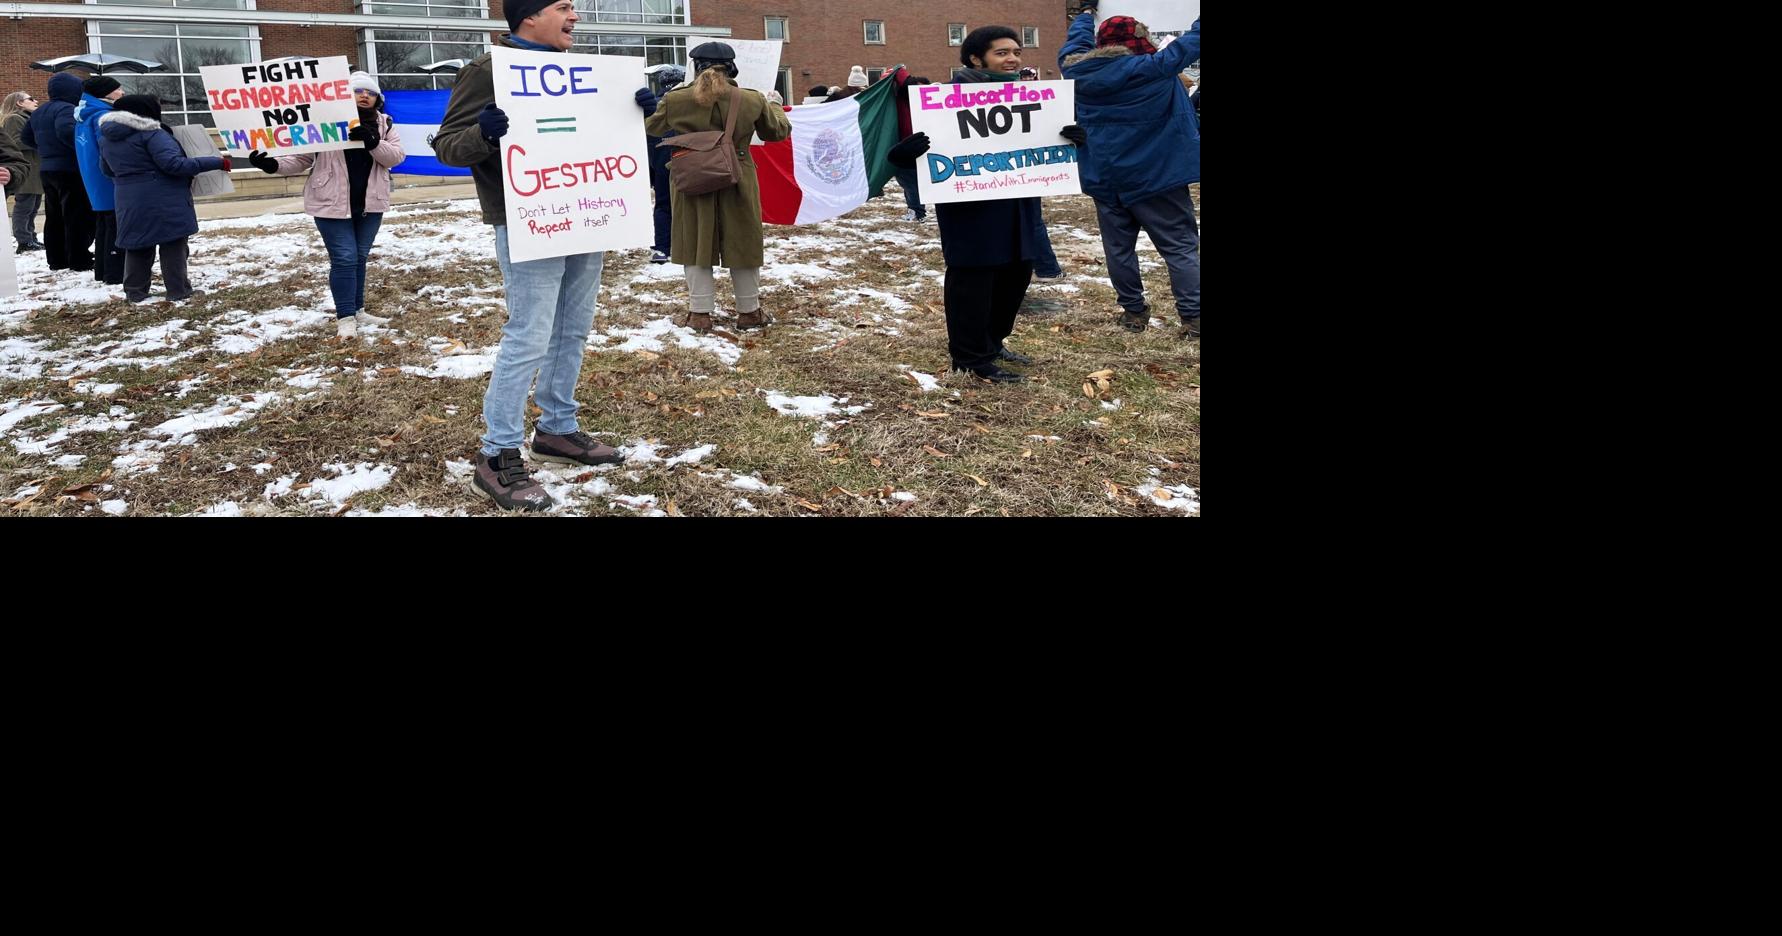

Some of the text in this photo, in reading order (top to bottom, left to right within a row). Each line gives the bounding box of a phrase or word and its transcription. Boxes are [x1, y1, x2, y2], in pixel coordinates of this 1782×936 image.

[241, 60, 319, 84] FIGHT
[510, 64, 598, 96] ICE
[208, 80, 352, 110] IGNORANCE
[919, 83, 1056, 110] Education
[262, 104, 311, 126] NOT
[956, 103, 1042, 139] NOT
[507, 144, 638, 196] GESTAPO
[927, 144, 1077, 184] DEPORTATION
[953, 173, 1070, 193] #StandWithImmigrants
[518, 197, 627, 219] Don't Let History
[527, 215, 611, 238] Repeat itself
